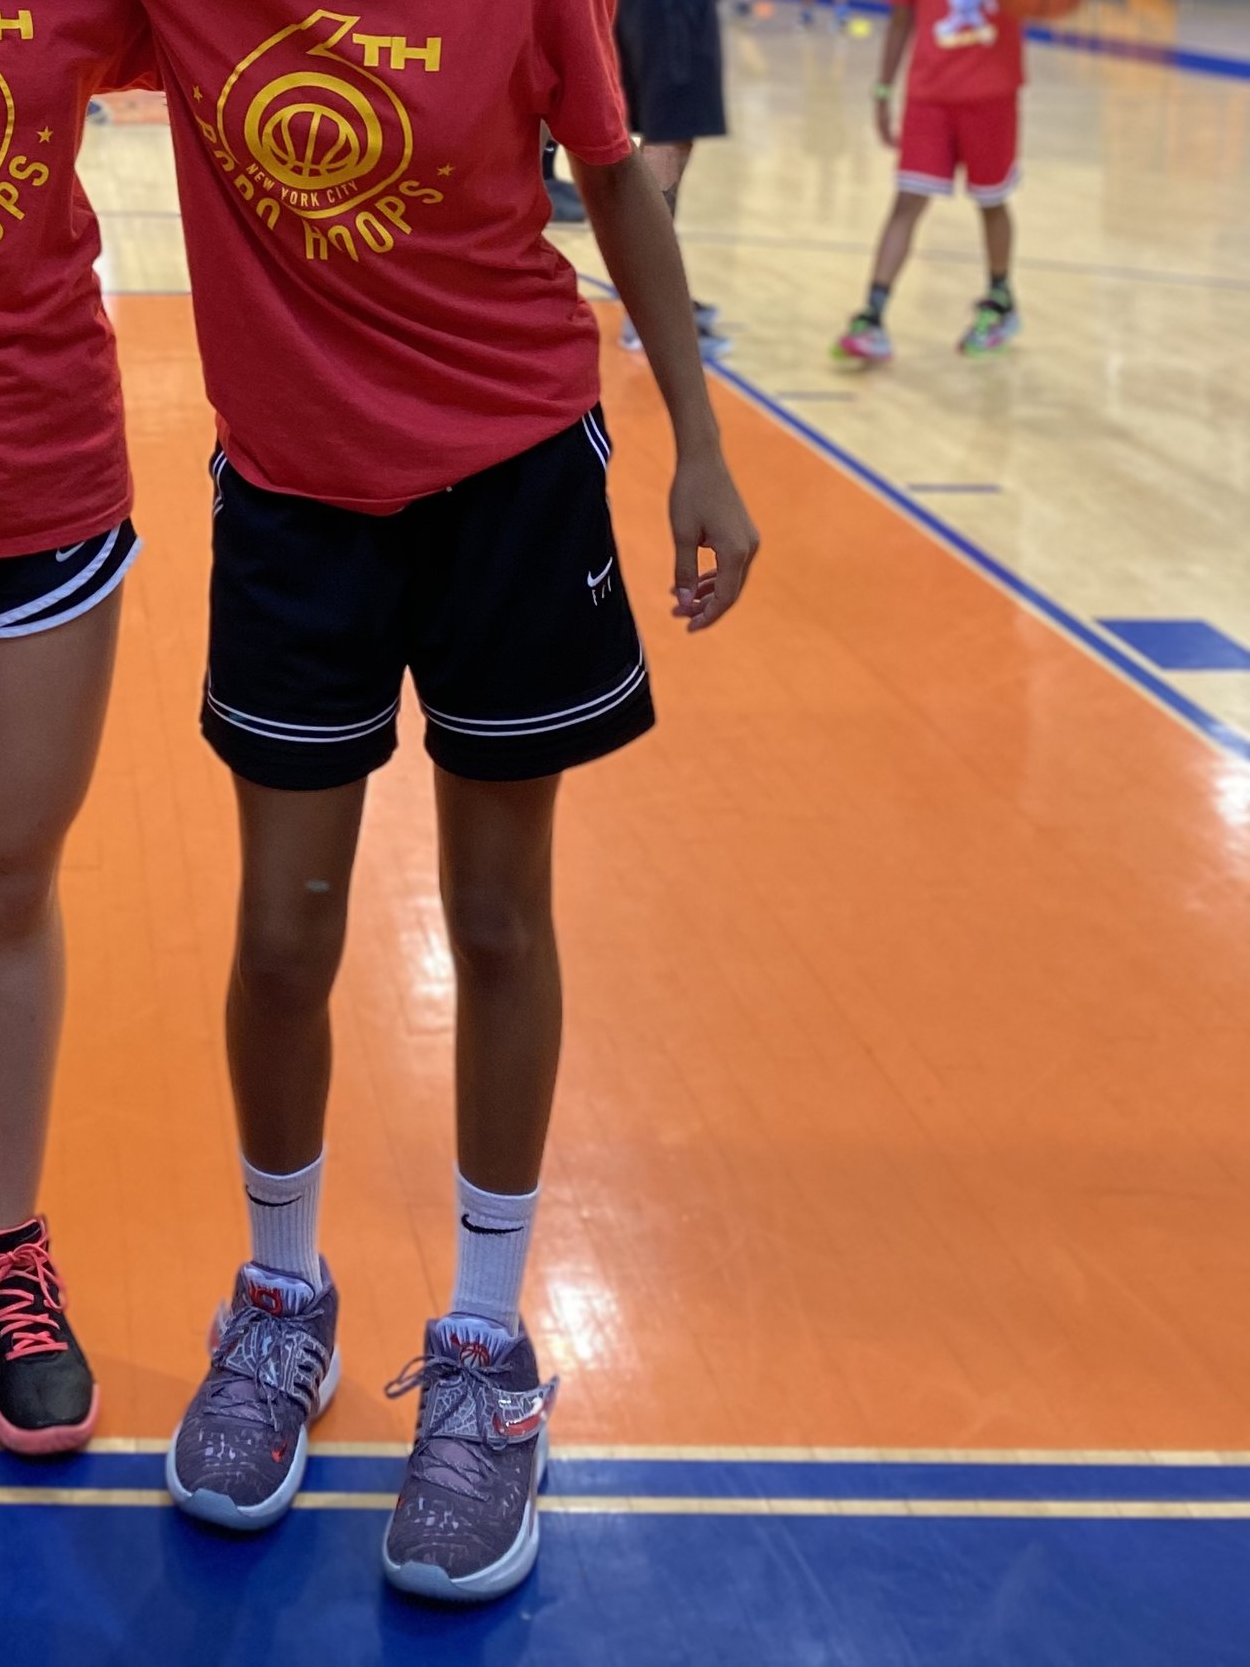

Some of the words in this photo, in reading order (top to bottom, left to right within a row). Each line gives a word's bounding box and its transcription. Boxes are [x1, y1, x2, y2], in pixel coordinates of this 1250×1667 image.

[216, 8, 442, 219] 6TH
[246, 162, 275, 191] NEW
[281, 185, 320, 208] YORK
[326, 179, 358, 204] CITY
